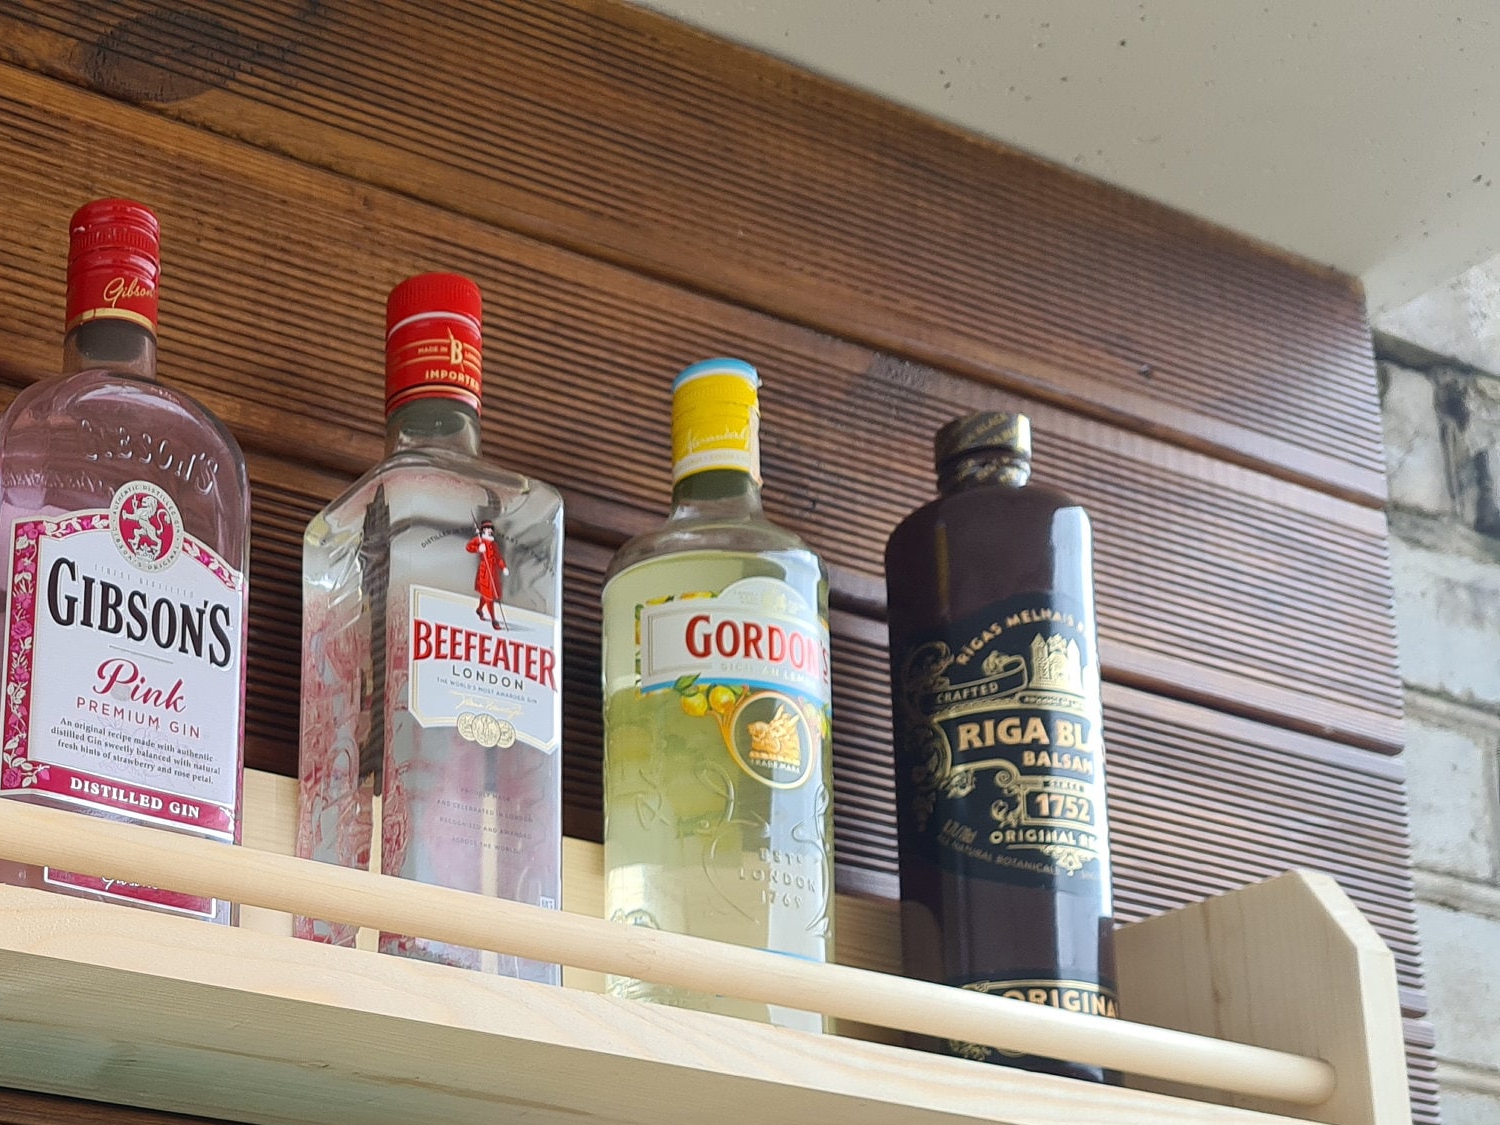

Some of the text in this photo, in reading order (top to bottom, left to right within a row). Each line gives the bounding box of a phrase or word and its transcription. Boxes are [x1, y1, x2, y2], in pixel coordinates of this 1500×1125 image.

[47, 557, 231, 668] GIBSON'S
[413, 618, 558, 692] BEEFEATER
[92, 658, 187, 713] Pink
[452, 664, 525, 692] LONDON
[60, 717, 214, 762] An original recipe made with authentic
[76, 696, 200, 739] PREMIUM GIN
[957, 716, 1051, 751] RIGA
[51, 726, 221, 775] distilled Gin sweetly balanced with natural
[58, 739, 214, 785] fresh hints of strawberry and rose petal.
[69, 776, 163, 811] DISTILLED
[169, 801, 201, 819] GIN
[1036, 792, 1091, 822] 1752
